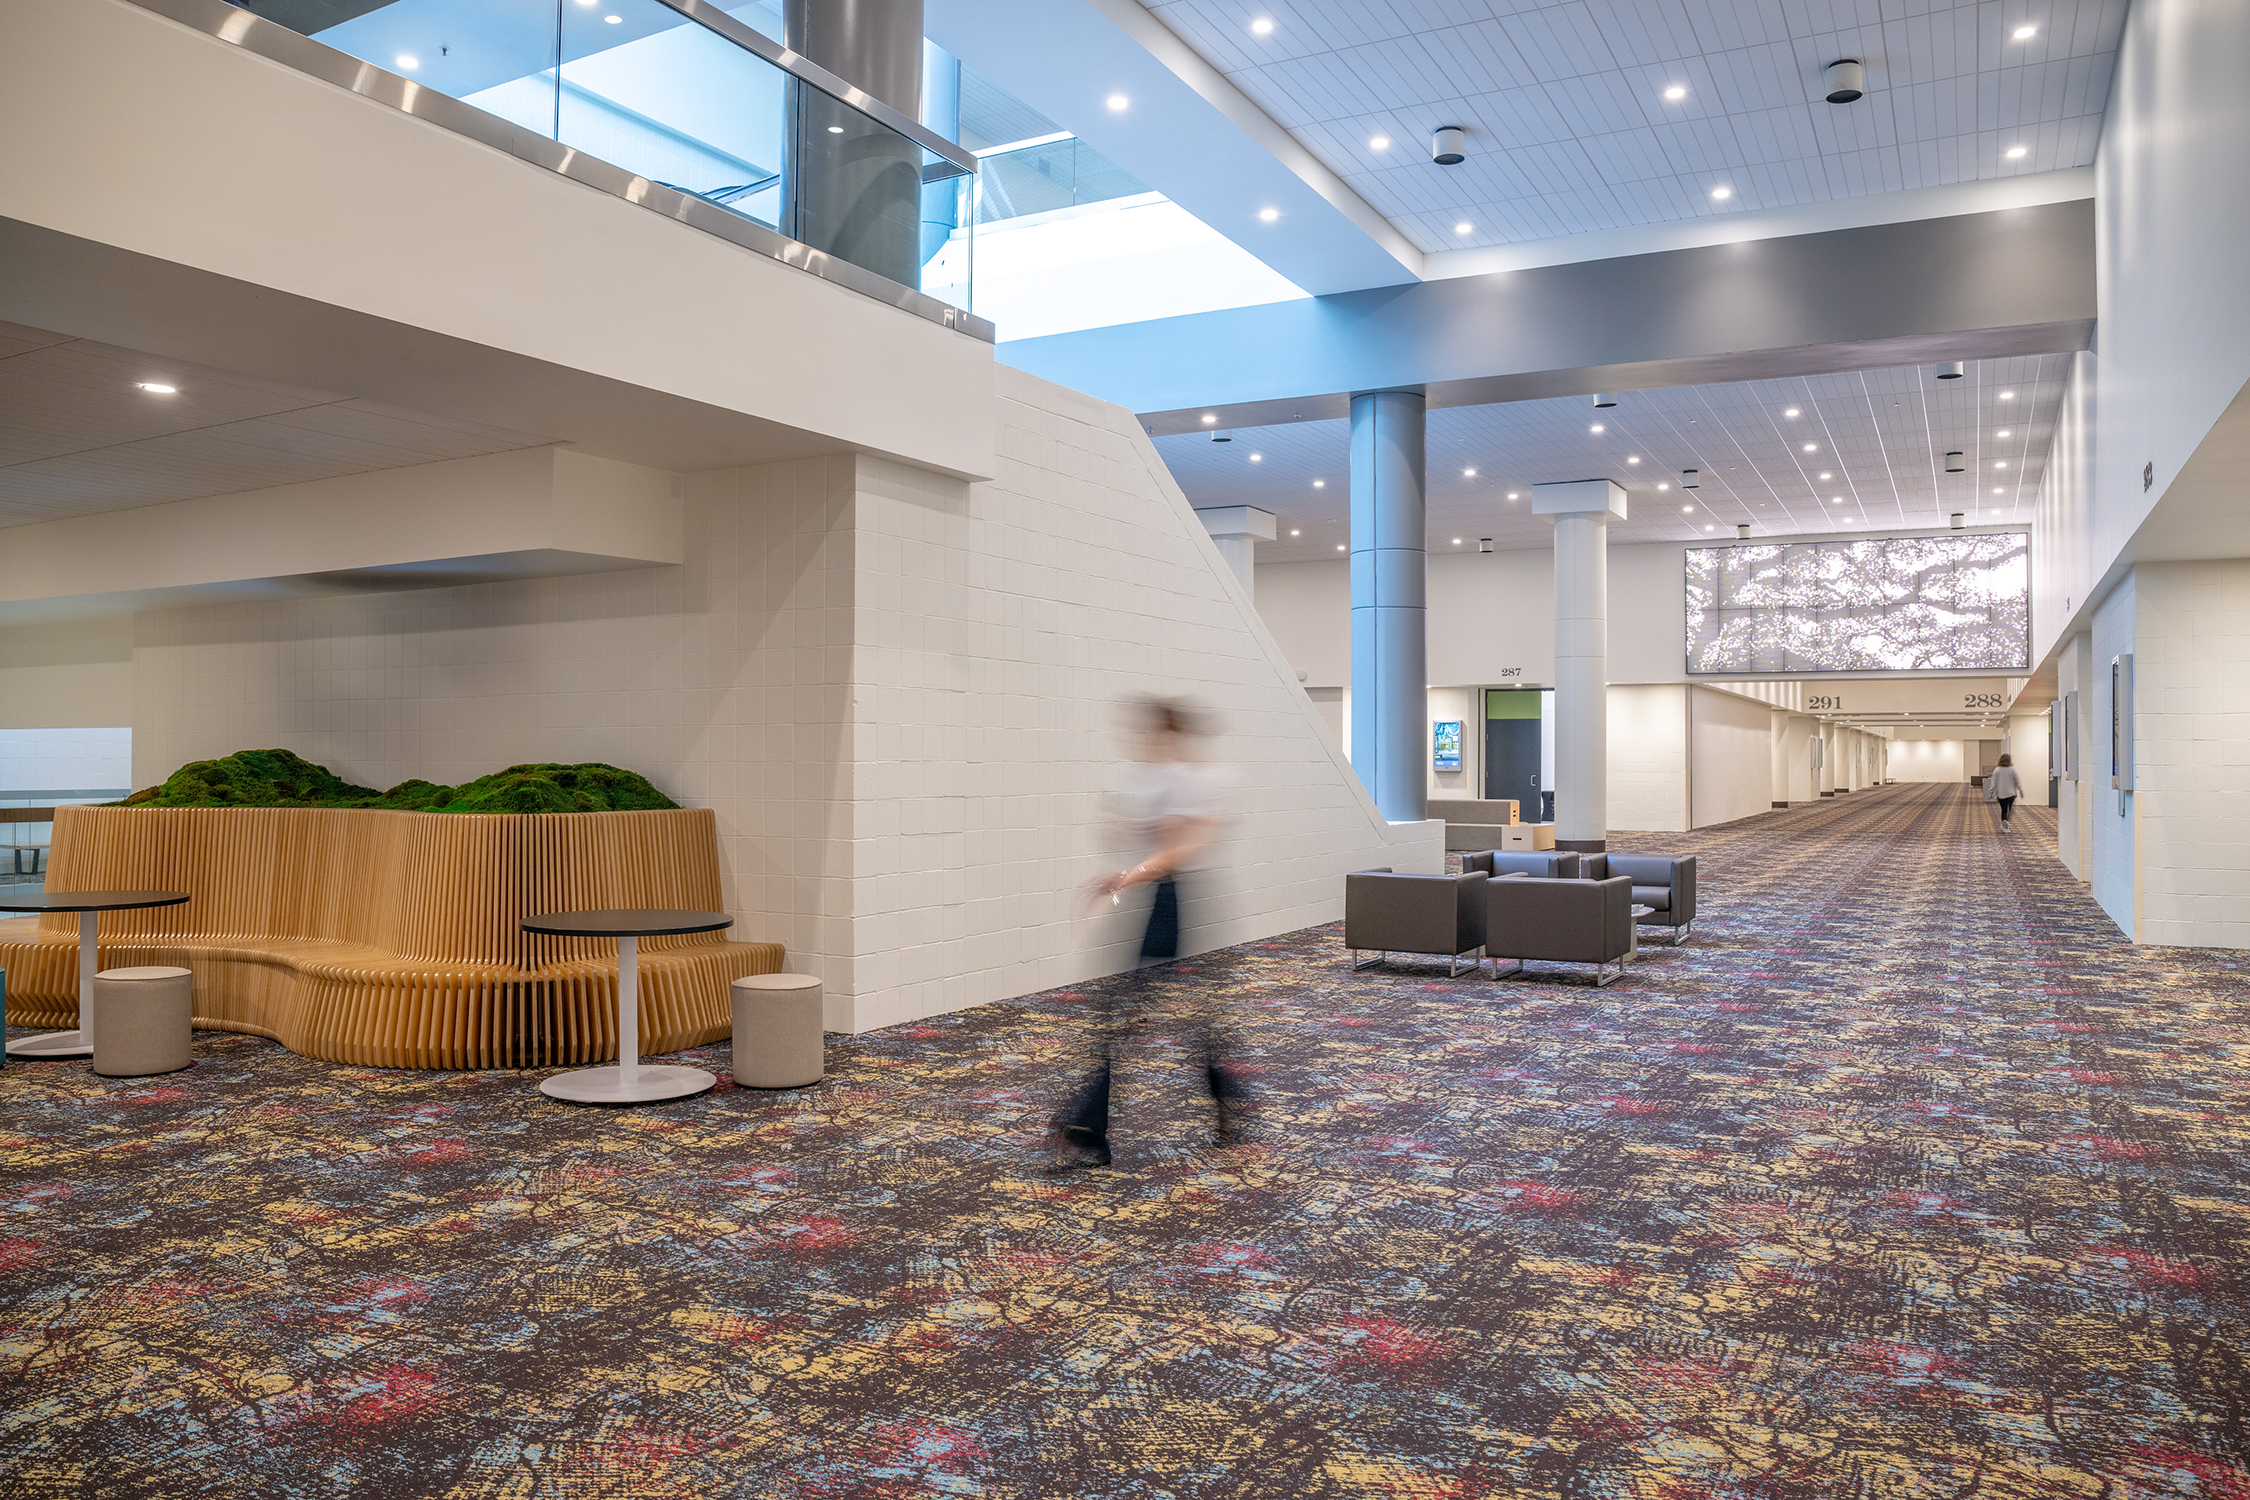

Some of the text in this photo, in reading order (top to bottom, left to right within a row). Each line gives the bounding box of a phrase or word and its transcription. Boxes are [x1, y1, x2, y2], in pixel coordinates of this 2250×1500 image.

[1501, 667, 1522, 677] 287
[1808, 695, 1844, 710] 291
[1964, 692, 2003, 708] 288
